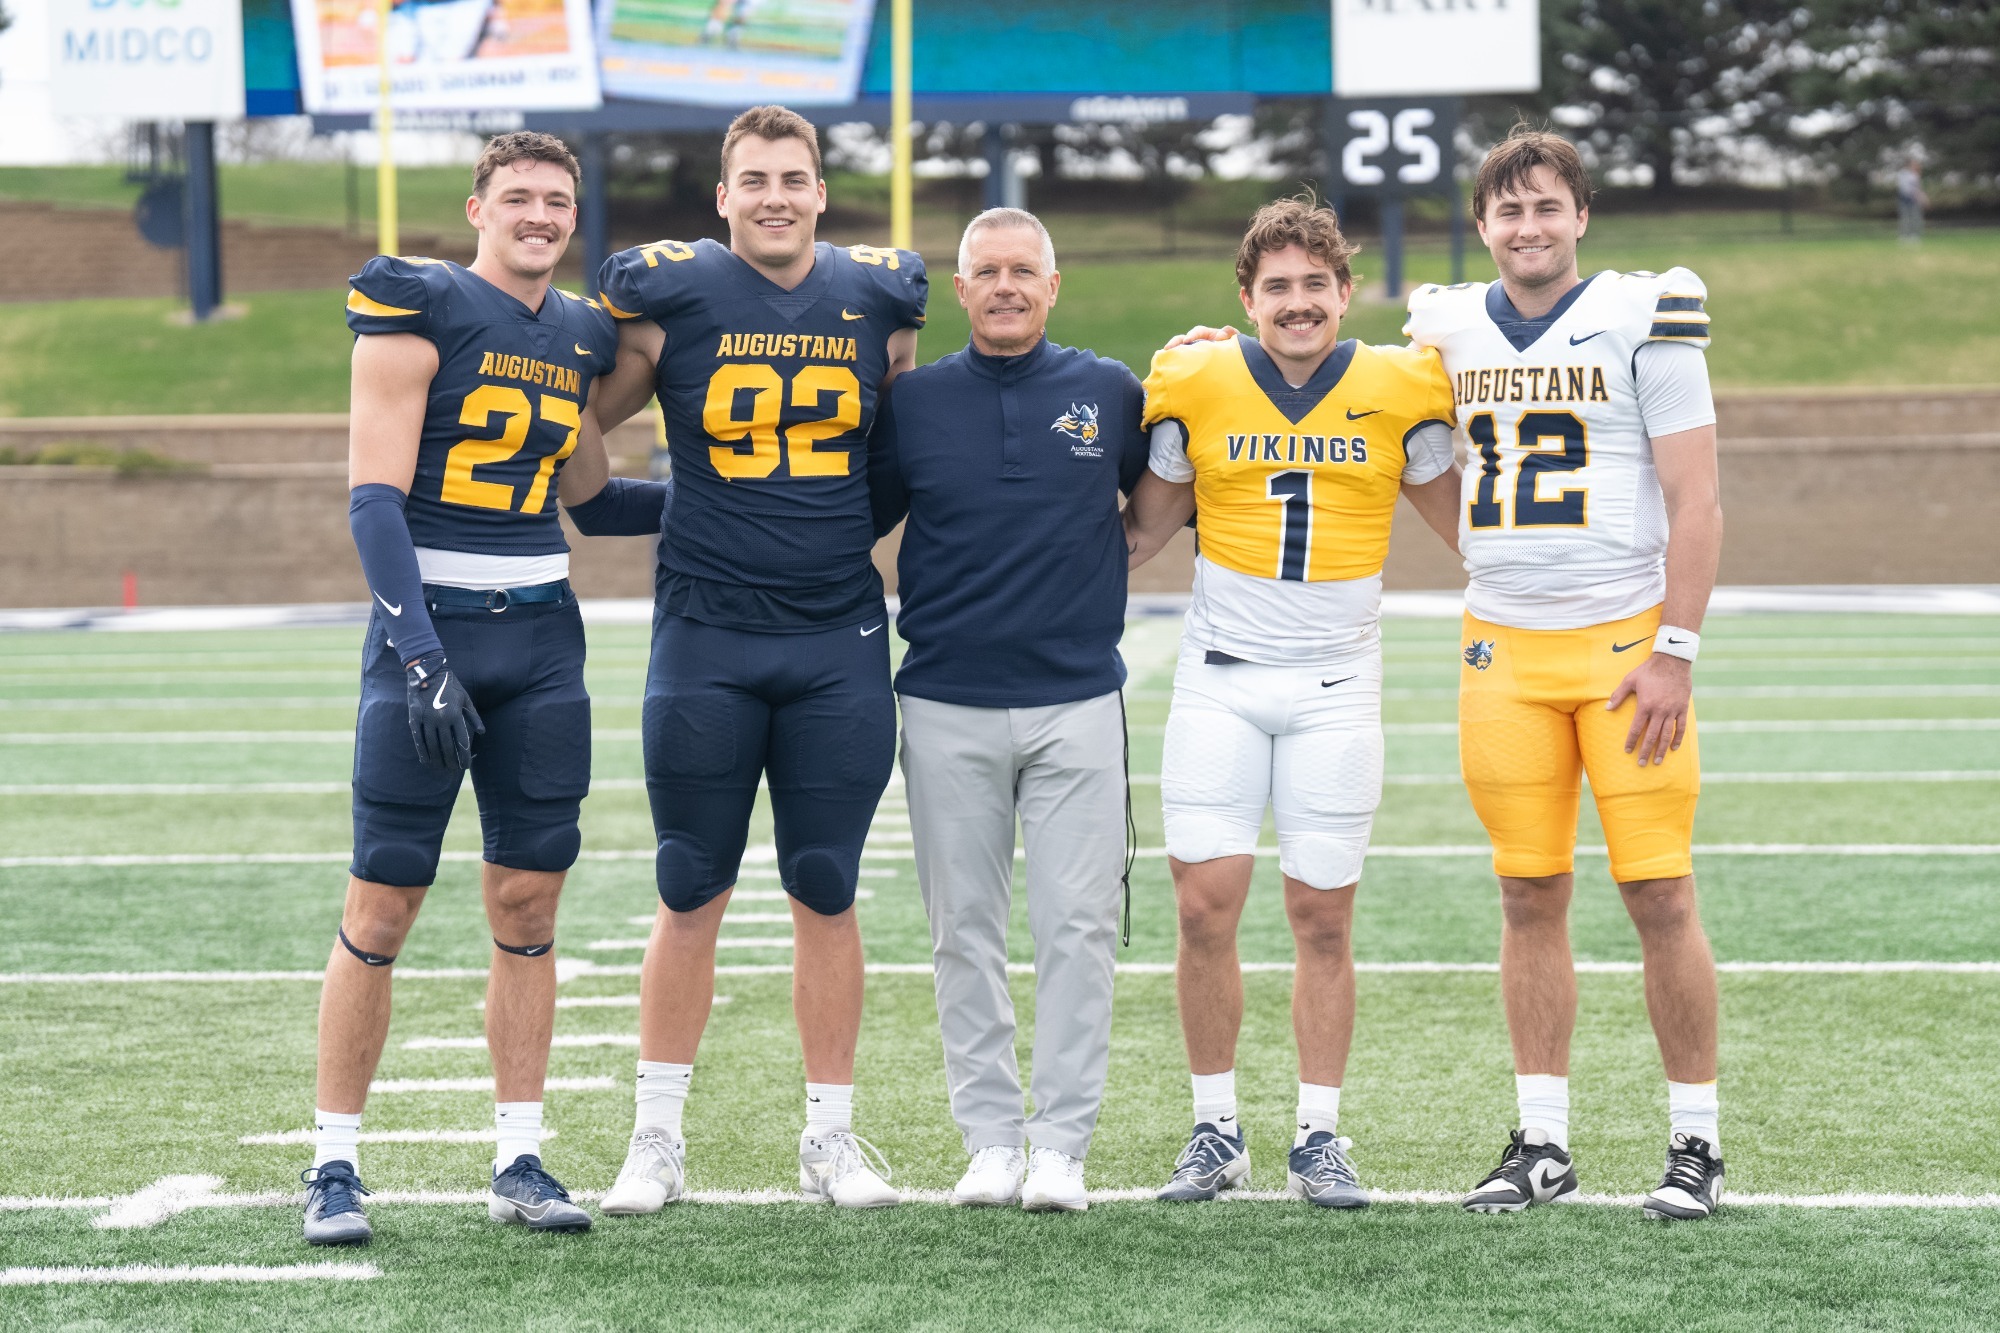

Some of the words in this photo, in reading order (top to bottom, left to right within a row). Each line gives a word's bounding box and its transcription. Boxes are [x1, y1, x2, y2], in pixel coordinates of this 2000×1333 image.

[62, 27, 213, 64] MIDCO
[1342, 108, 1441, 185] 25
[716, 333, 858, 362] AUGUSTANA
[440, 384, 582, 515] 27
[703, 363, 862, 479] 92
[1227, 433, 1369, 464] VIKINGS
[1466, 409, 1590, 532] 12
[1265, 468, 1316, 583] 1
